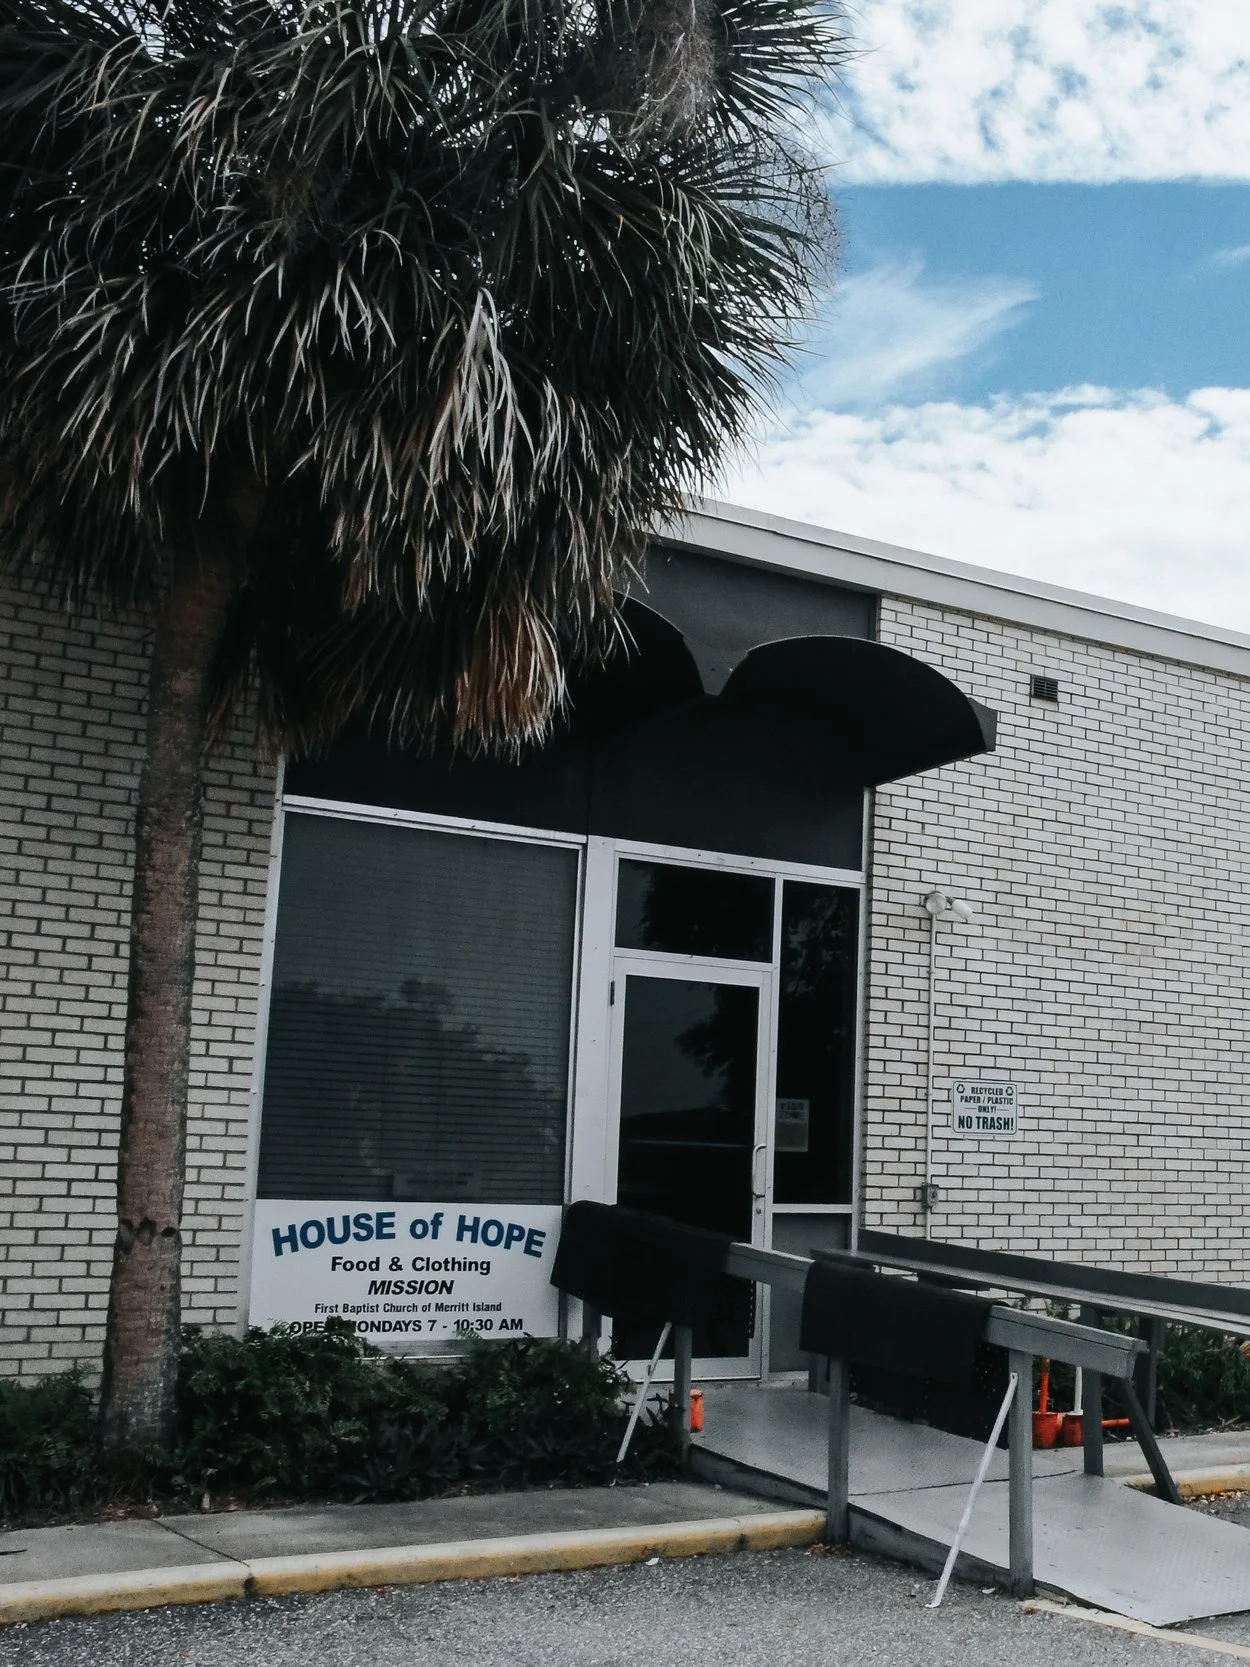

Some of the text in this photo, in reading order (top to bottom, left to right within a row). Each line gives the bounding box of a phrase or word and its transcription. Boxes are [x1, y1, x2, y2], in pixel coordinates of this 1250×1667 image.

[970, 1086, 1004, 1096] RECYCLED
[960, 1095, 981, 1104] PAPER
[987, 1097, 1014, 1105] PLASTIC
[977, 1105, 997, 1113] ONLY!
[958, 1115, 1014, 1131] NO TRASH!
[271, 1211, 547, 1258] HOUSE of HOPE
[331, 1256, 491, 1275] Food & Clothing
[367, 1279, 455, 1296] MISSION
[314, 1302, 502, 1315] First Baptist Church of Merritt Island
[290, 1321, 327, 1334] OPE
[353, 1320, 422, 1333] ONDAYS
[427, 1320, 438, 1332] 7
[453, 1319, 494, 1331] 10:30
[498, 1319, 523, 1331] AM
